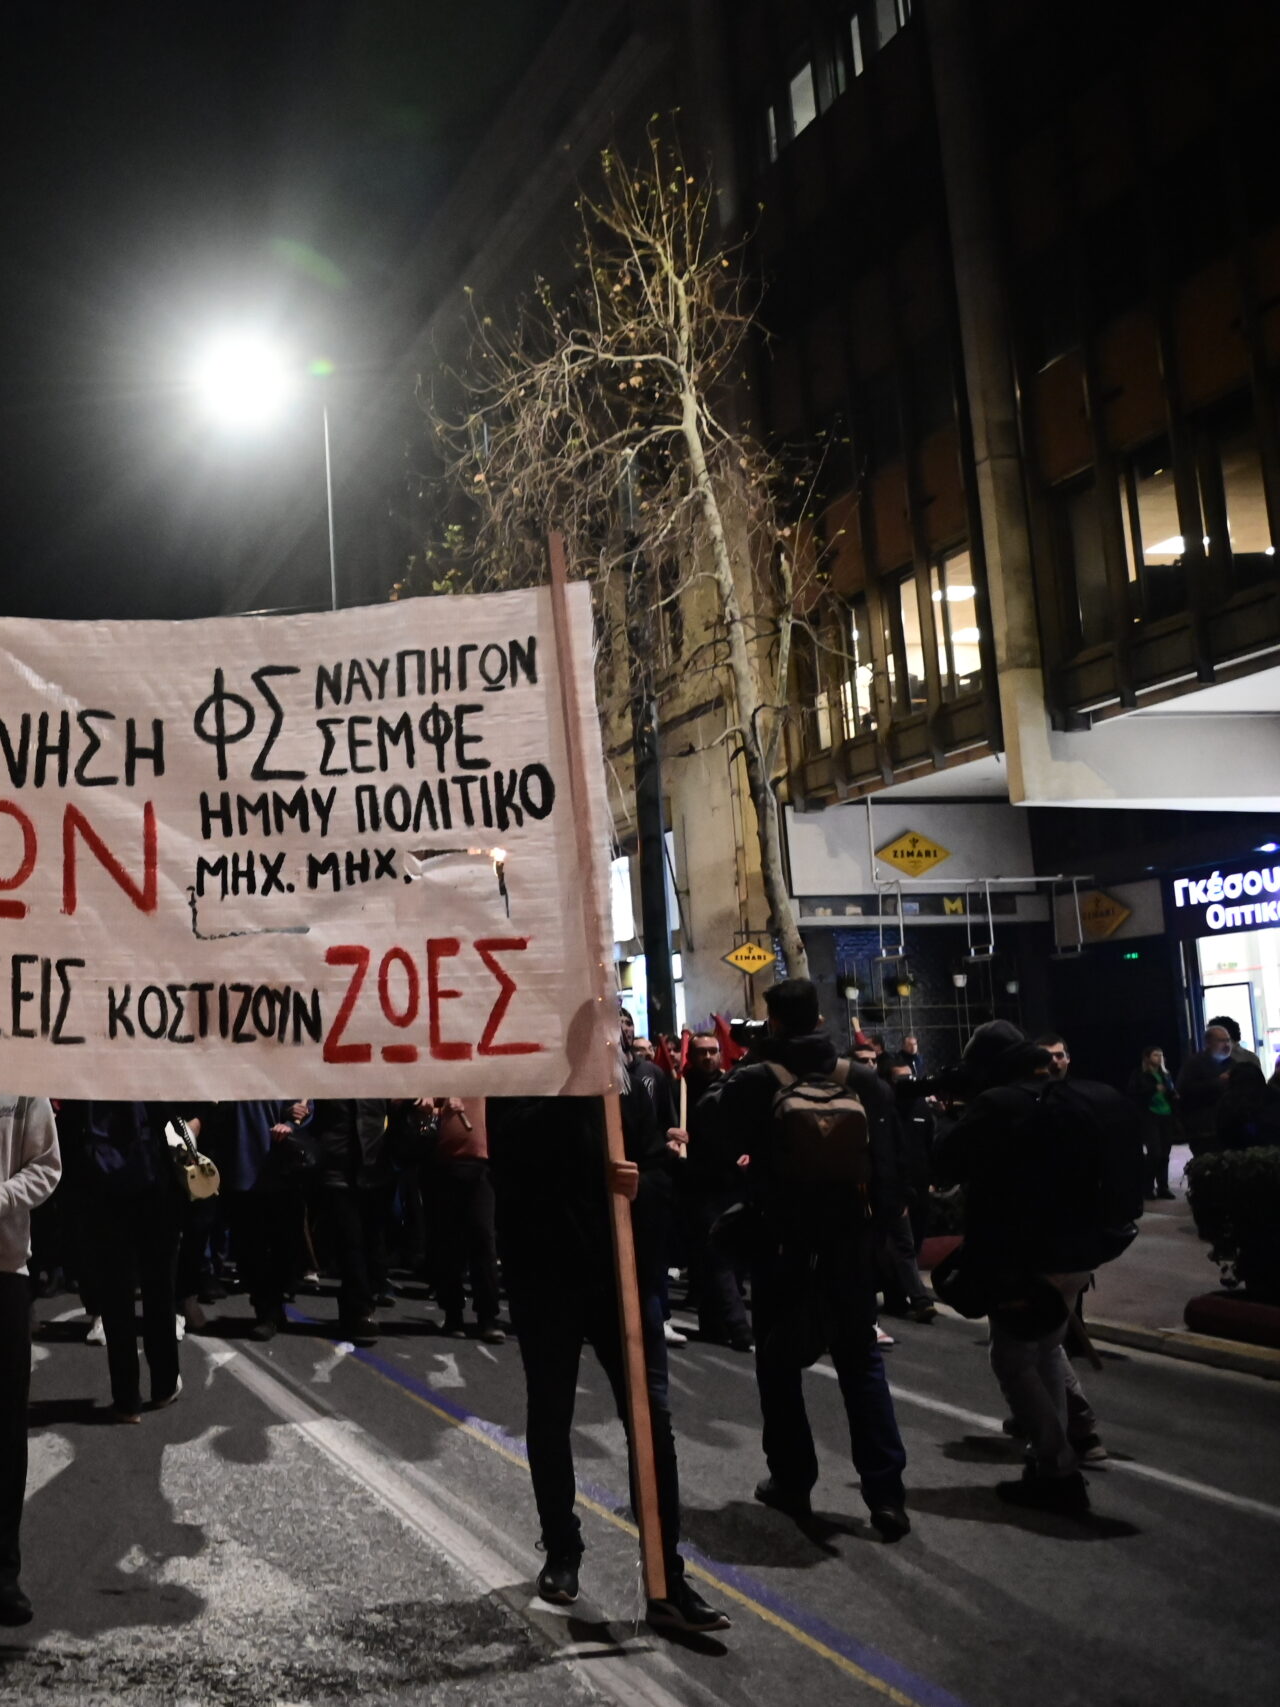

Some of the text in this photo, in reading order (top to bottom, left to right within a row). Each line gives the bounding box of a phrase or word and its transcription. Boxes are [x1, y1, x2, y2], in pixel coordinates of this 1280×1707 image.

[193, 664, 308, 782] ΦΣ
[316, 701, 492, 777] ΣΕΜΦΕ
[199, 762, 556, 841] ΗΜΜΥ ΠΟΛΙΤΙΚΟ
[196, 847, 413, 901] ΜΗΧ. ΜΗΧ.
[892, 849, 939, 859] ZIMARI
[1205, 900, 1280, 930] Οπτικ
[107, 982, 323, 1046] ΚΟΣΤΙΖΟΥΝ
